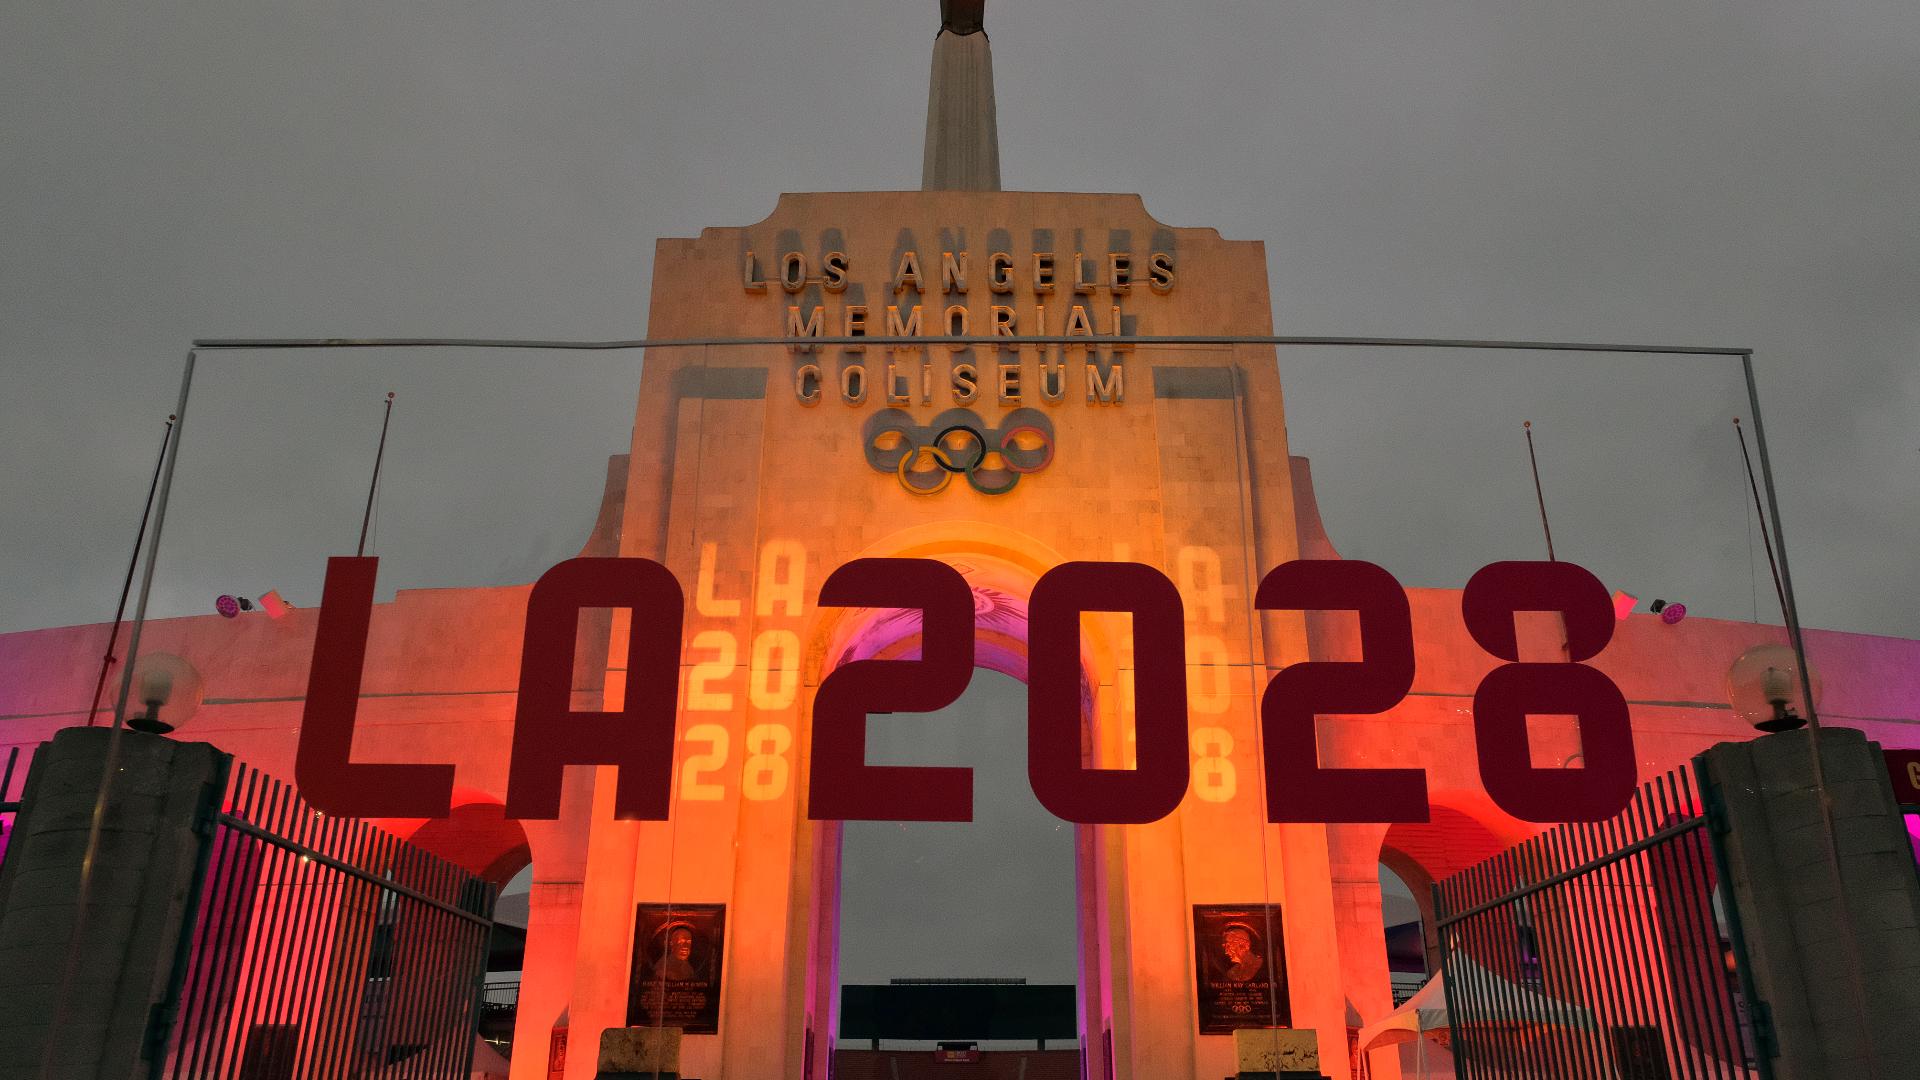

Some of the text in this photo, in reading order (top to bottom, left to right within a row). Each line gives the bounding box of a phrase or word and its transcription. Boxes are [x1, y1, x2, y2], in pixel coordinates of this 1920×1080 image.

[744, 251, 1176, 295] LOS ANGELES
[787, 304, 1136, 353] MEMORIAL
[795, 363, 1125, 407] COLISEUM
[696, 539, 806, 617] LA
[295, 556, 1637, 825] LA 2028
[687, 630, 800, 711] 20
[680, 723, 791, 801] 28
